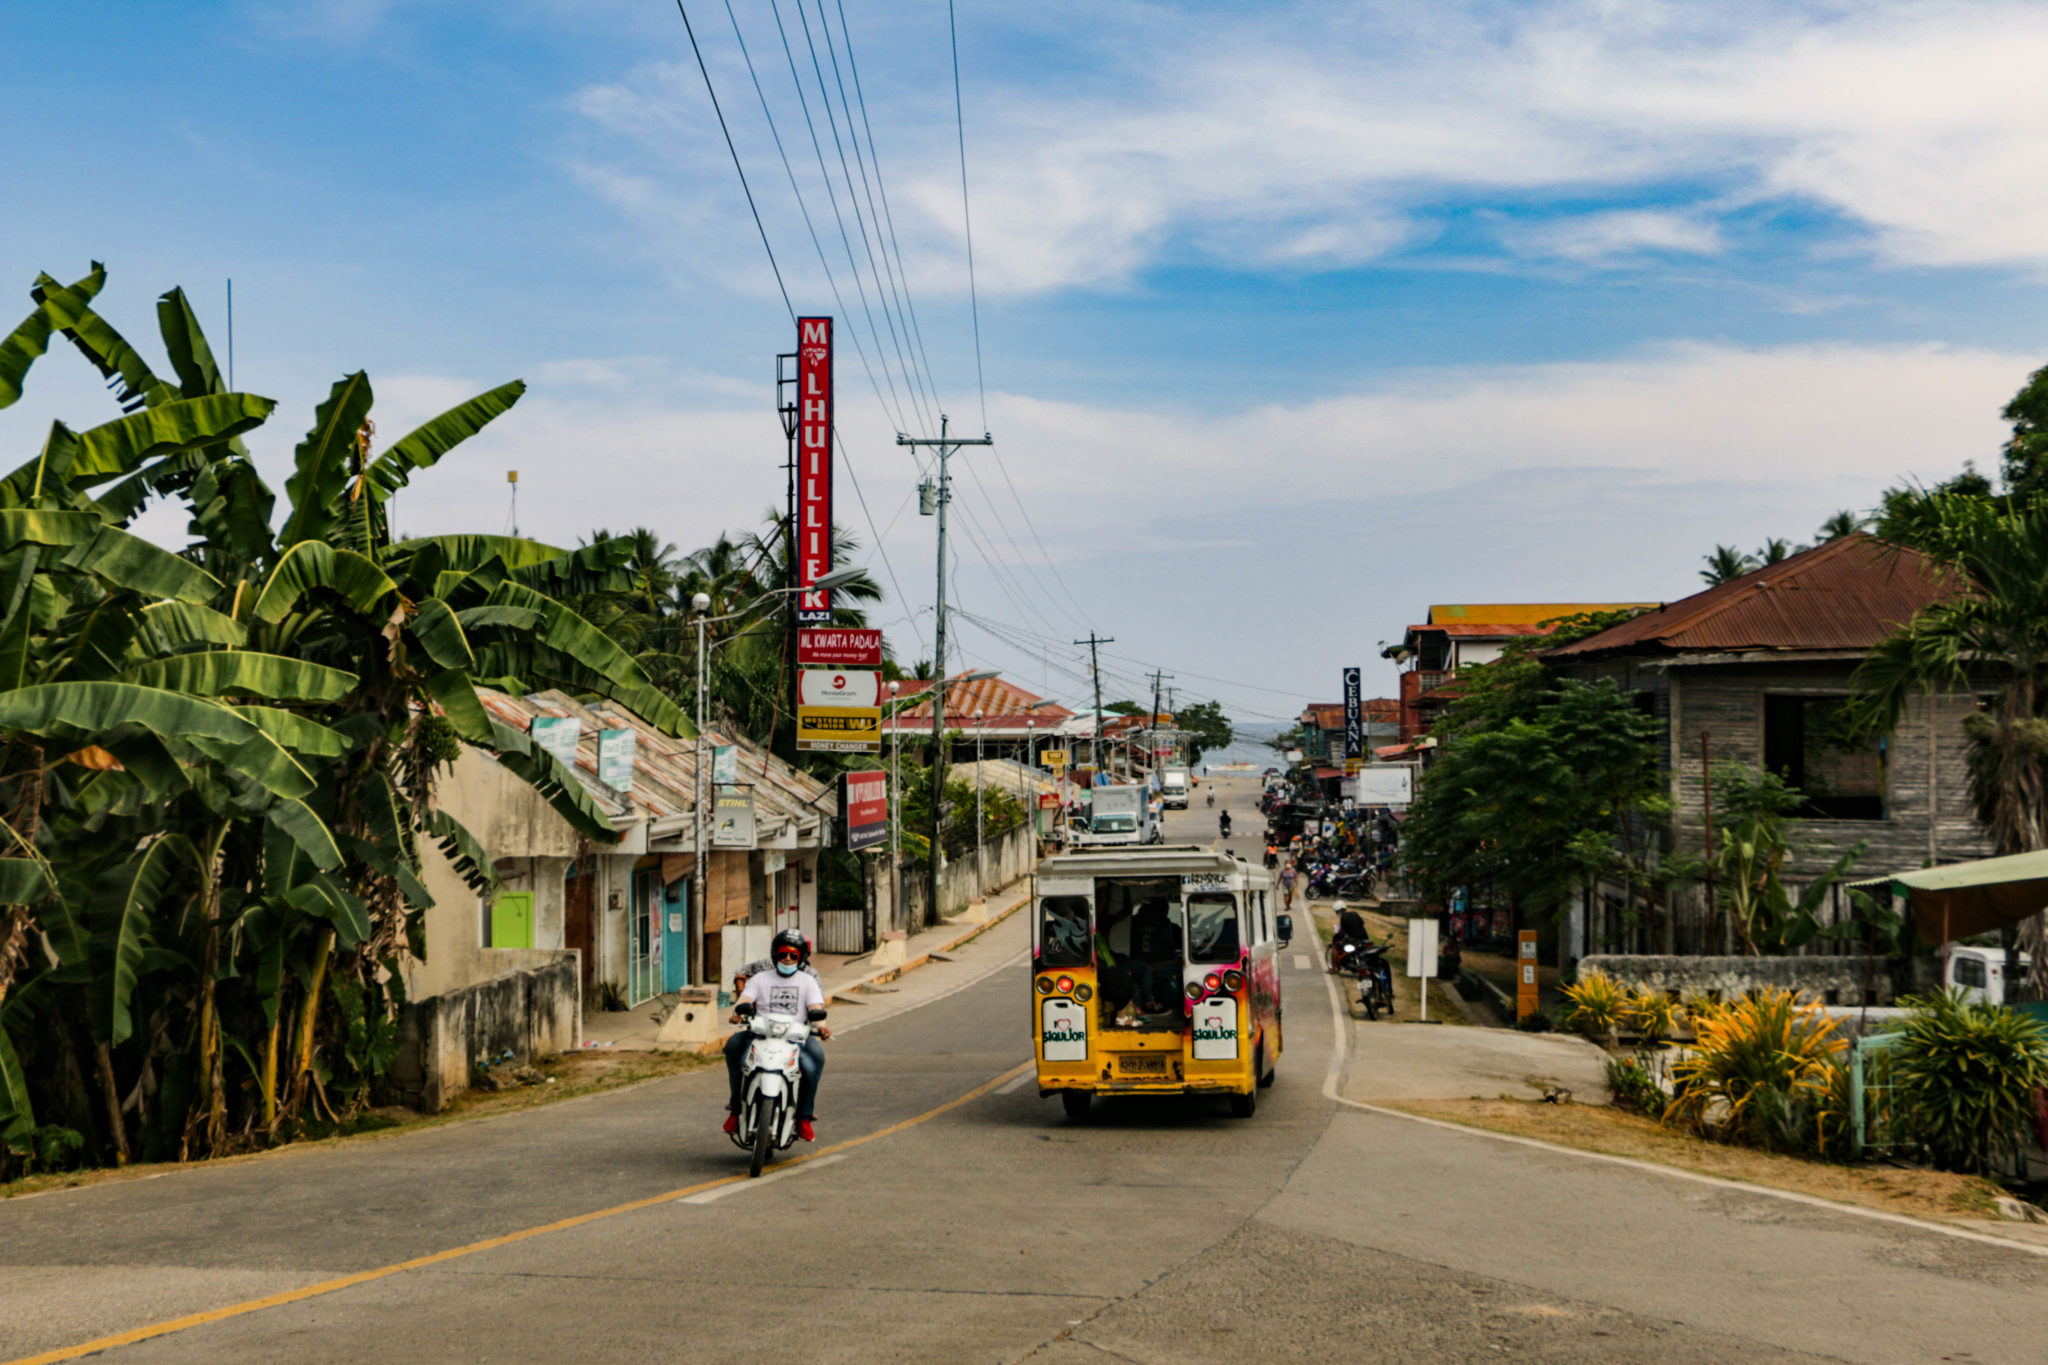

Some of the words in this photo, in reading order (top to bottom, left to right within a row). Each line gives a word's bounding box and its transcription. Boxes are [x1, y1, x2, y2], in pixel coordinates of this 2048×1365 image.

[799, 611, 830, 621] LAZI
[800, 633, 812, 648] ML
[814, 633, 847, 648] KWARTA
[849, 633, 880, 649] PADALA
[1345, 669, 1359, 753] CEBUANA
[717, 799, 748, 807] STIHL
